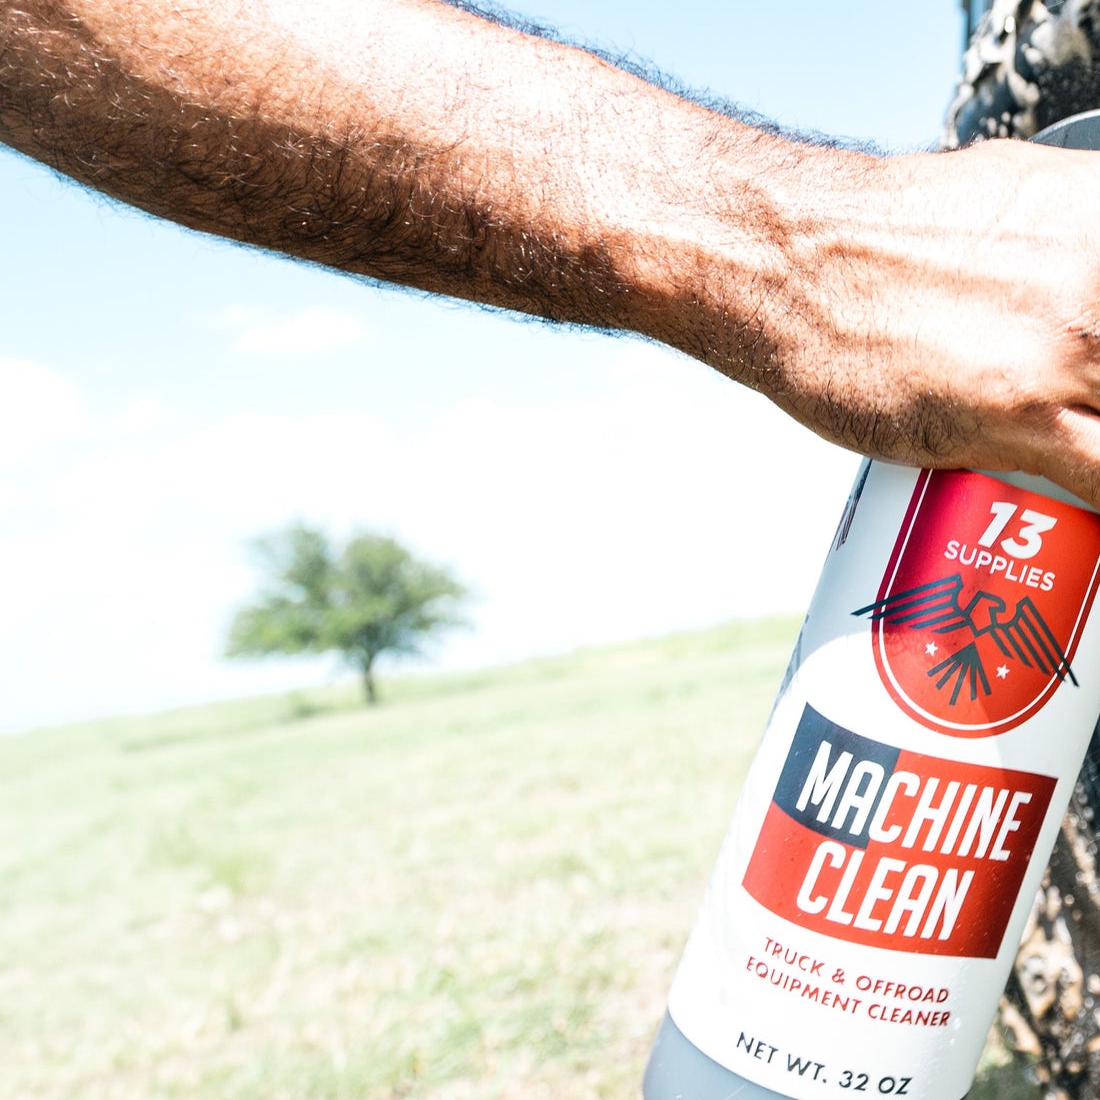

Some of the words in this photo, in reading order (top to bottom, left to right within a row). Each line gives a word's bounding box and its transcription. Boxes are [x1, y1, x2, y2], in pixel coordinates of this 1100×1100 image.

[977, 501, 1059, 560] 13
[943, 539, 1057, 592] SUPPLIES
[795, 739, 1034, 862] MACHINE
[796, 840, 976, 941] CLEAN
[746, 955, 863, 1015] EQUIPMENT
[867, 1003, 951, 1027] CLEANER
[763, 936, 825, 977] TRUCK
[831, 967, 846, 985] &
[855, 975, 950, 1004] OFFROAD
[736, 1031, 779, 1064] NET
[786, 1053, 828, 1084] WT.
[838, 1070, 870, 1091] 32
[877, 1076, 913, 1095] OZ
